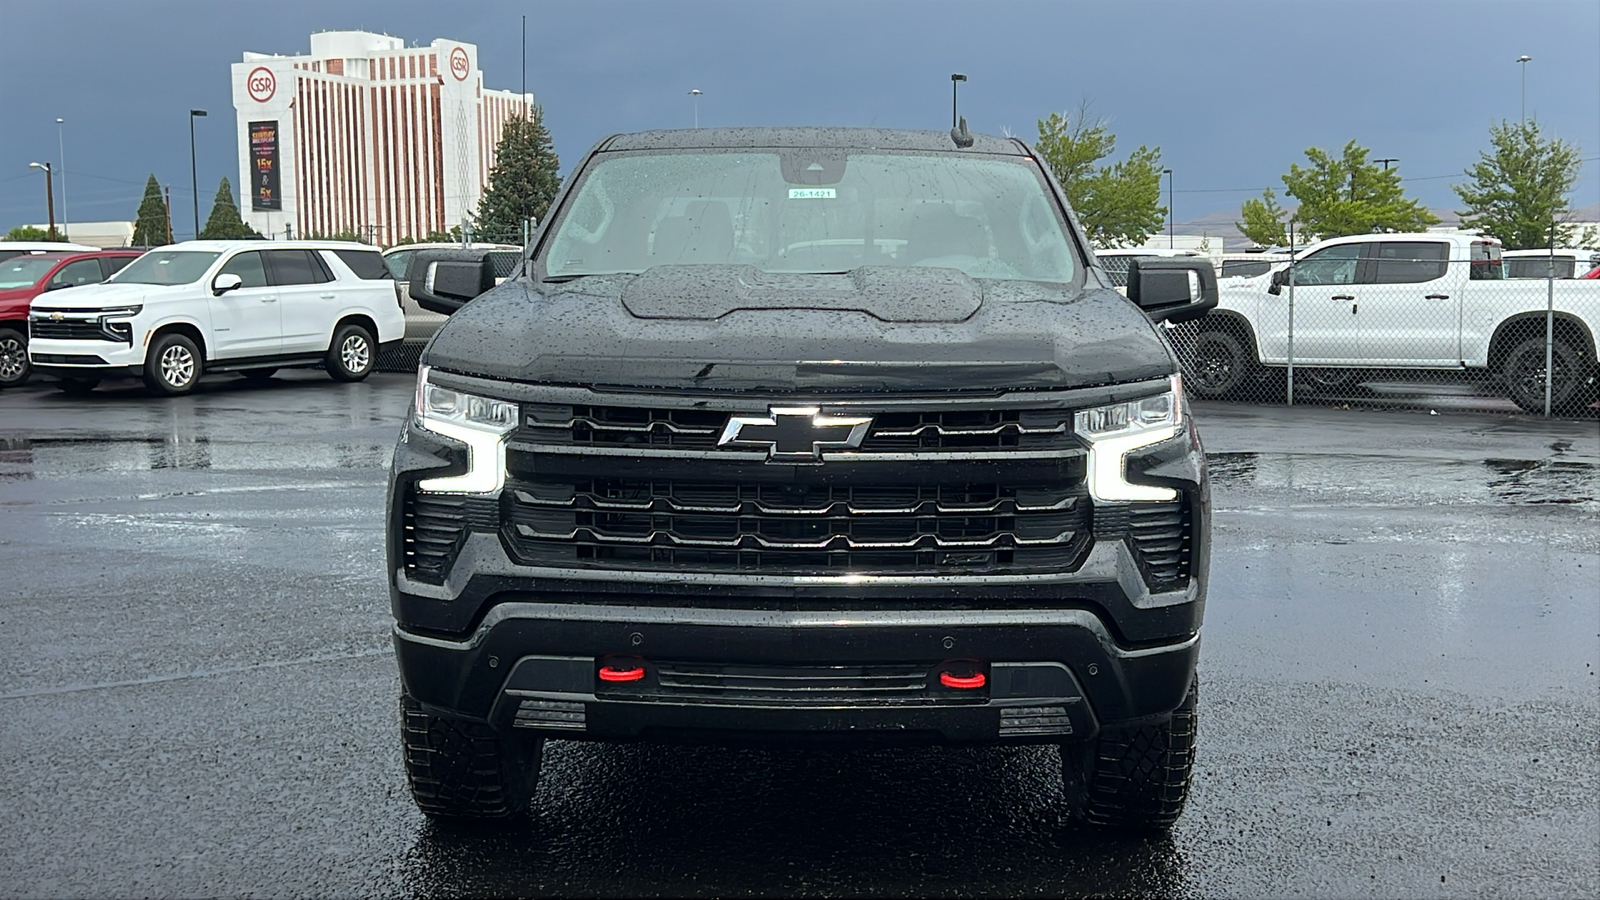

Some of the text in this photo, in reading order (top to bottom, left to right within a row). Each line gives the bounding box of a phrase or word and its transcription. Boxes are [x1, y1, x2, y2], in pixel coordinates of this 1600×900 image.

[452, 56, 467, 72] GSR
[251, 77, 272, 92] GSR
[262, 175, 269, 186] &
[793, 190, 831, 198] 26-1421
